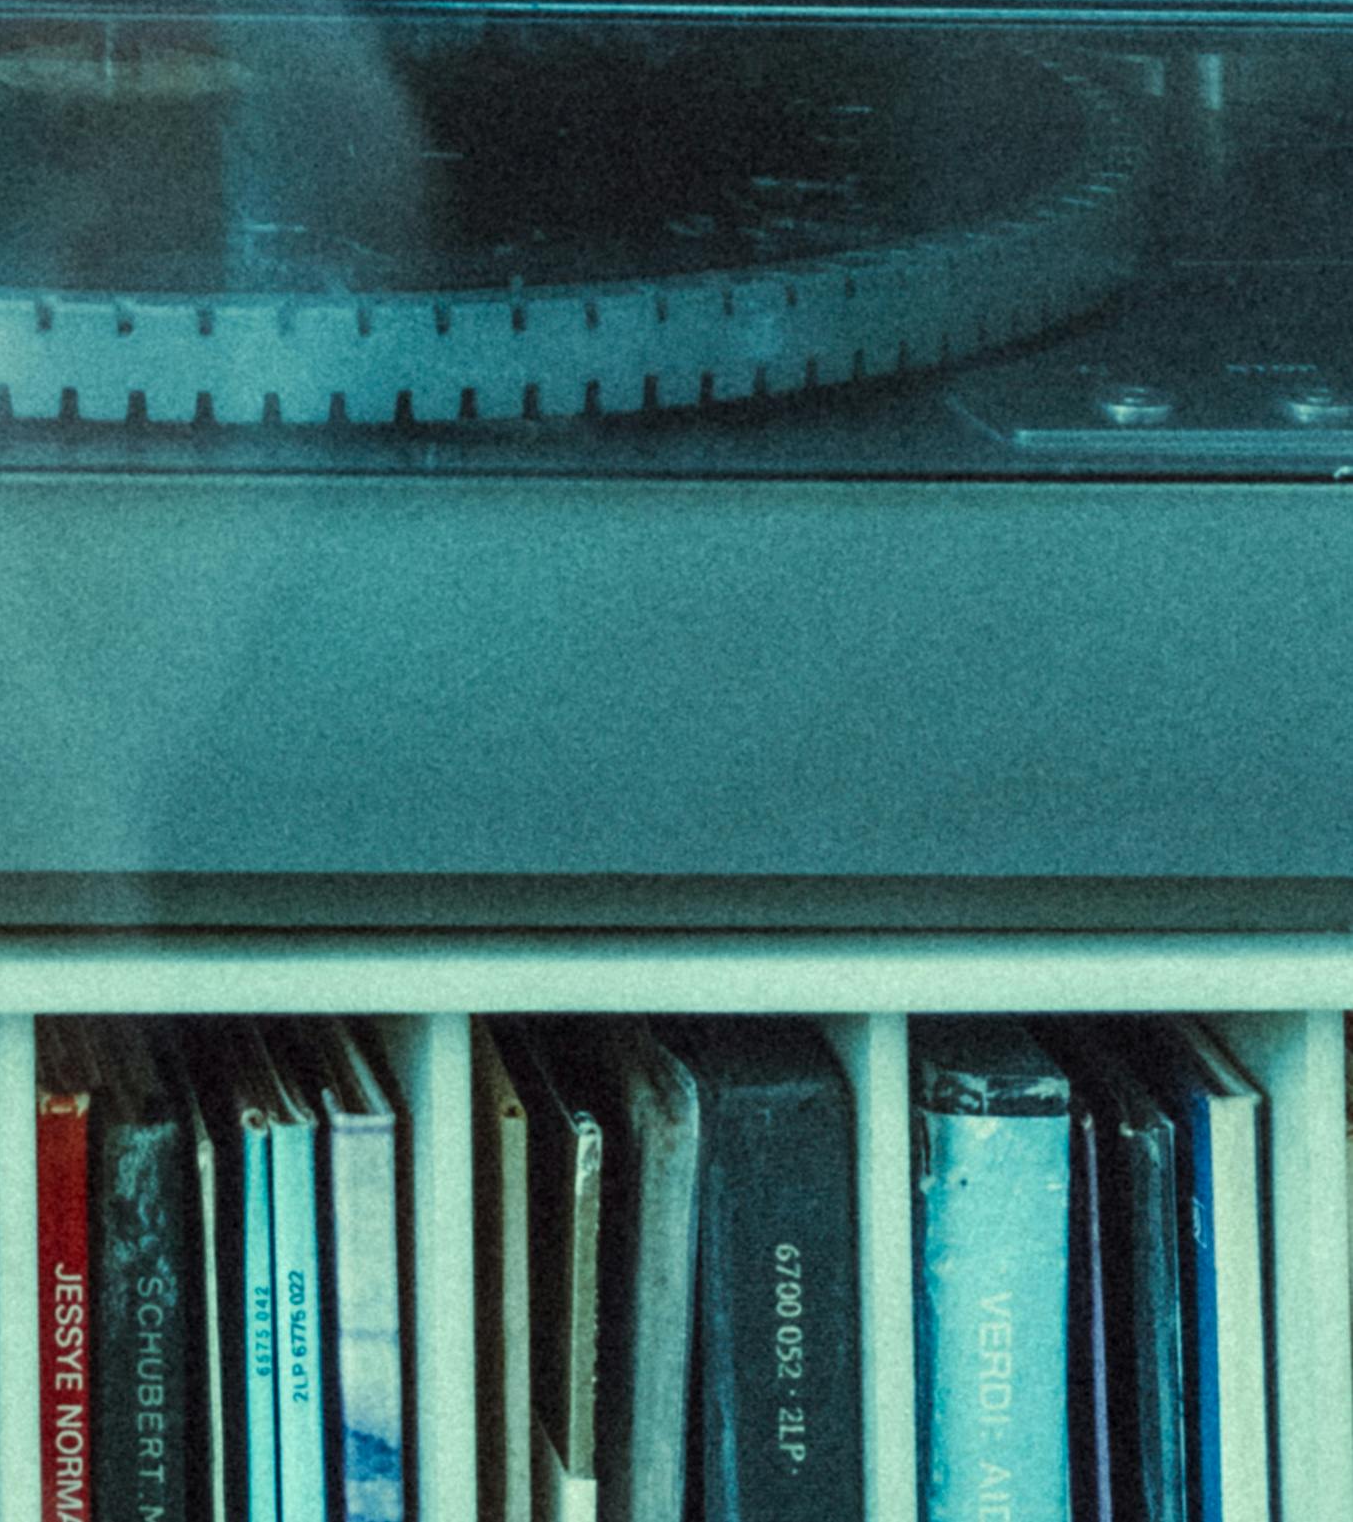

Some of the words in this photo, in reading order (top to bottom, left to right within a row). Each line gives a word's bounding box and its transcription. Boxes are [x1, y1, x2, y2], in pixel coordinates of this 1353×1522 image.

[254, 1286, 271, 1322] 042
[288, 1270, 306, 1306] 022
[774, 1242, 802, 1319] 6700
[54, 1261, 84, 1391] JESSYE
[290, 1309, 308, 1359] 6775
[775, 1325, 803, 1380] 052
[292, 1363, 310, 1403] 2LP
